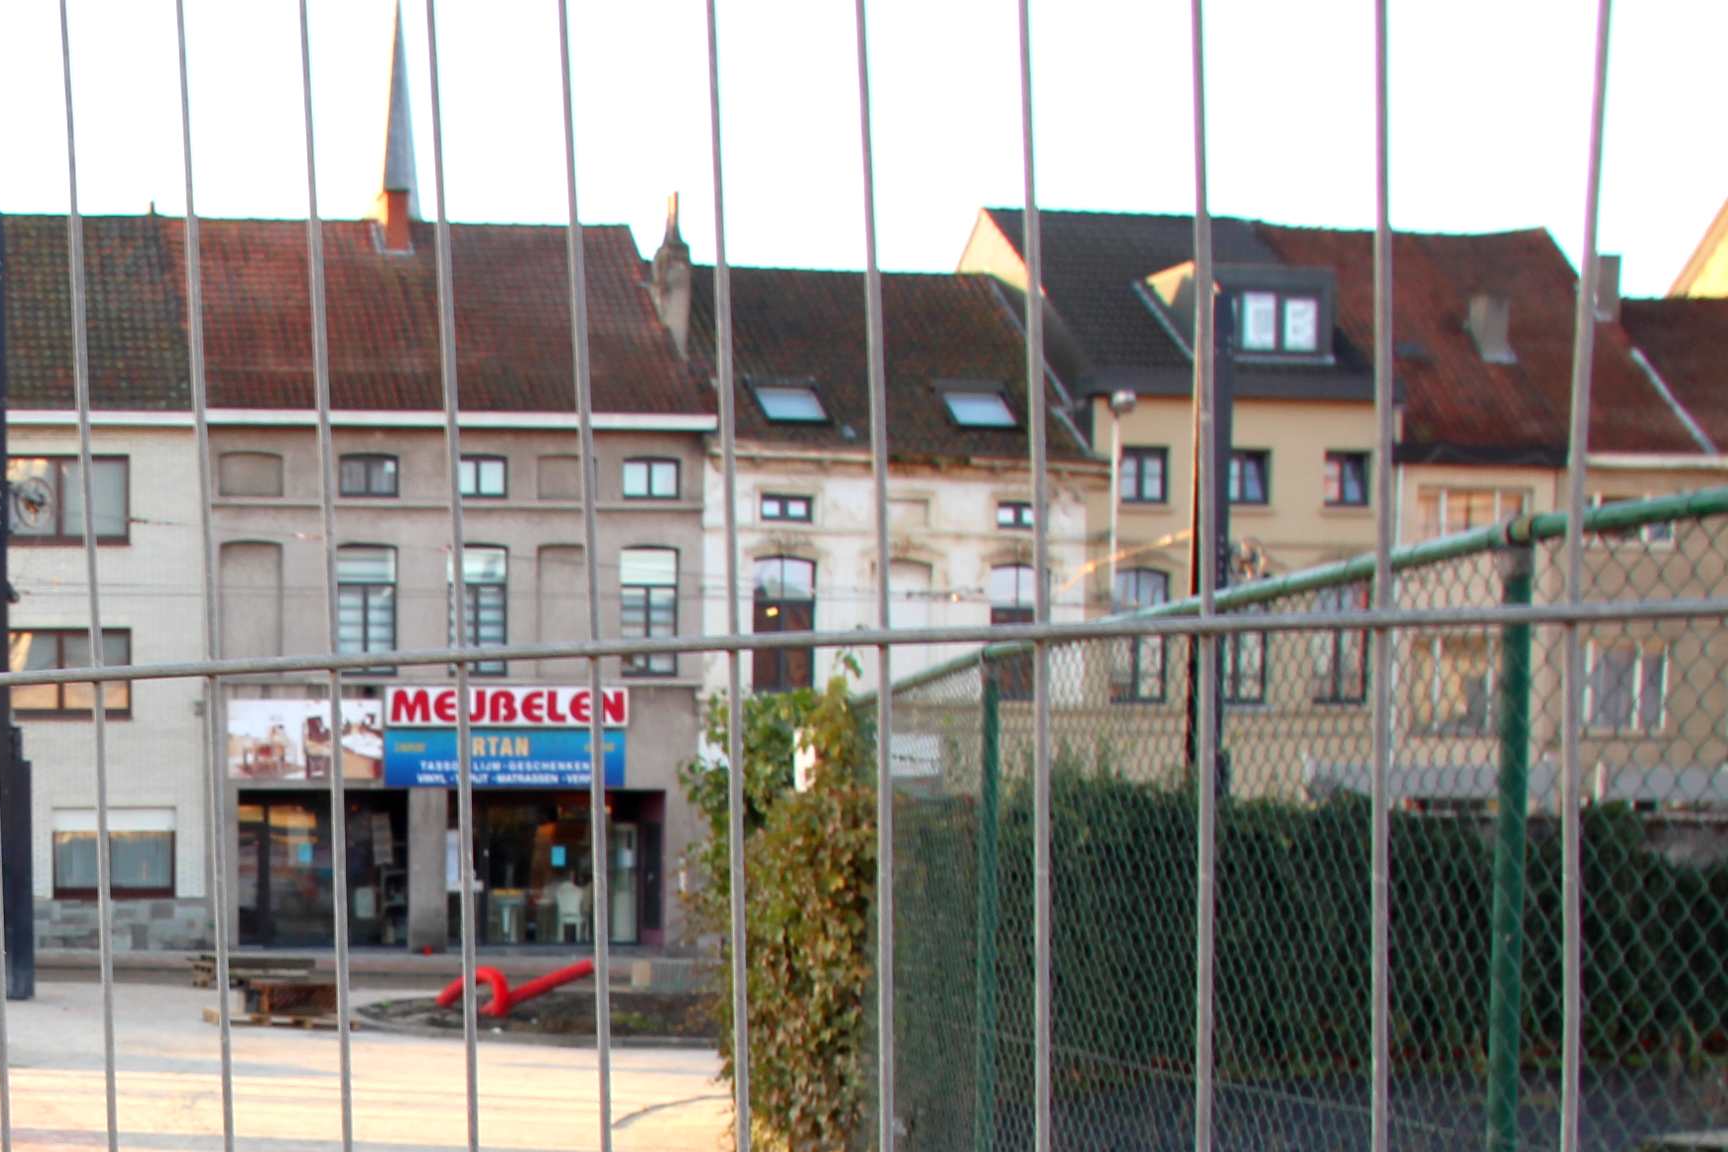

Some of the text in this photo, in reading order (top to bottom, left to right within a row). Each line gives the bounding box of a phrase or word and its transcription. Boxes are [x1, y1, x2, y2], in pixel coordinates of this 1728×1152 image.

[391, 688, 626, 723] MEUBELEN
[458, 736, 529, 757] RTAN
[508, 760, 591, 771] GESCHENKEN
